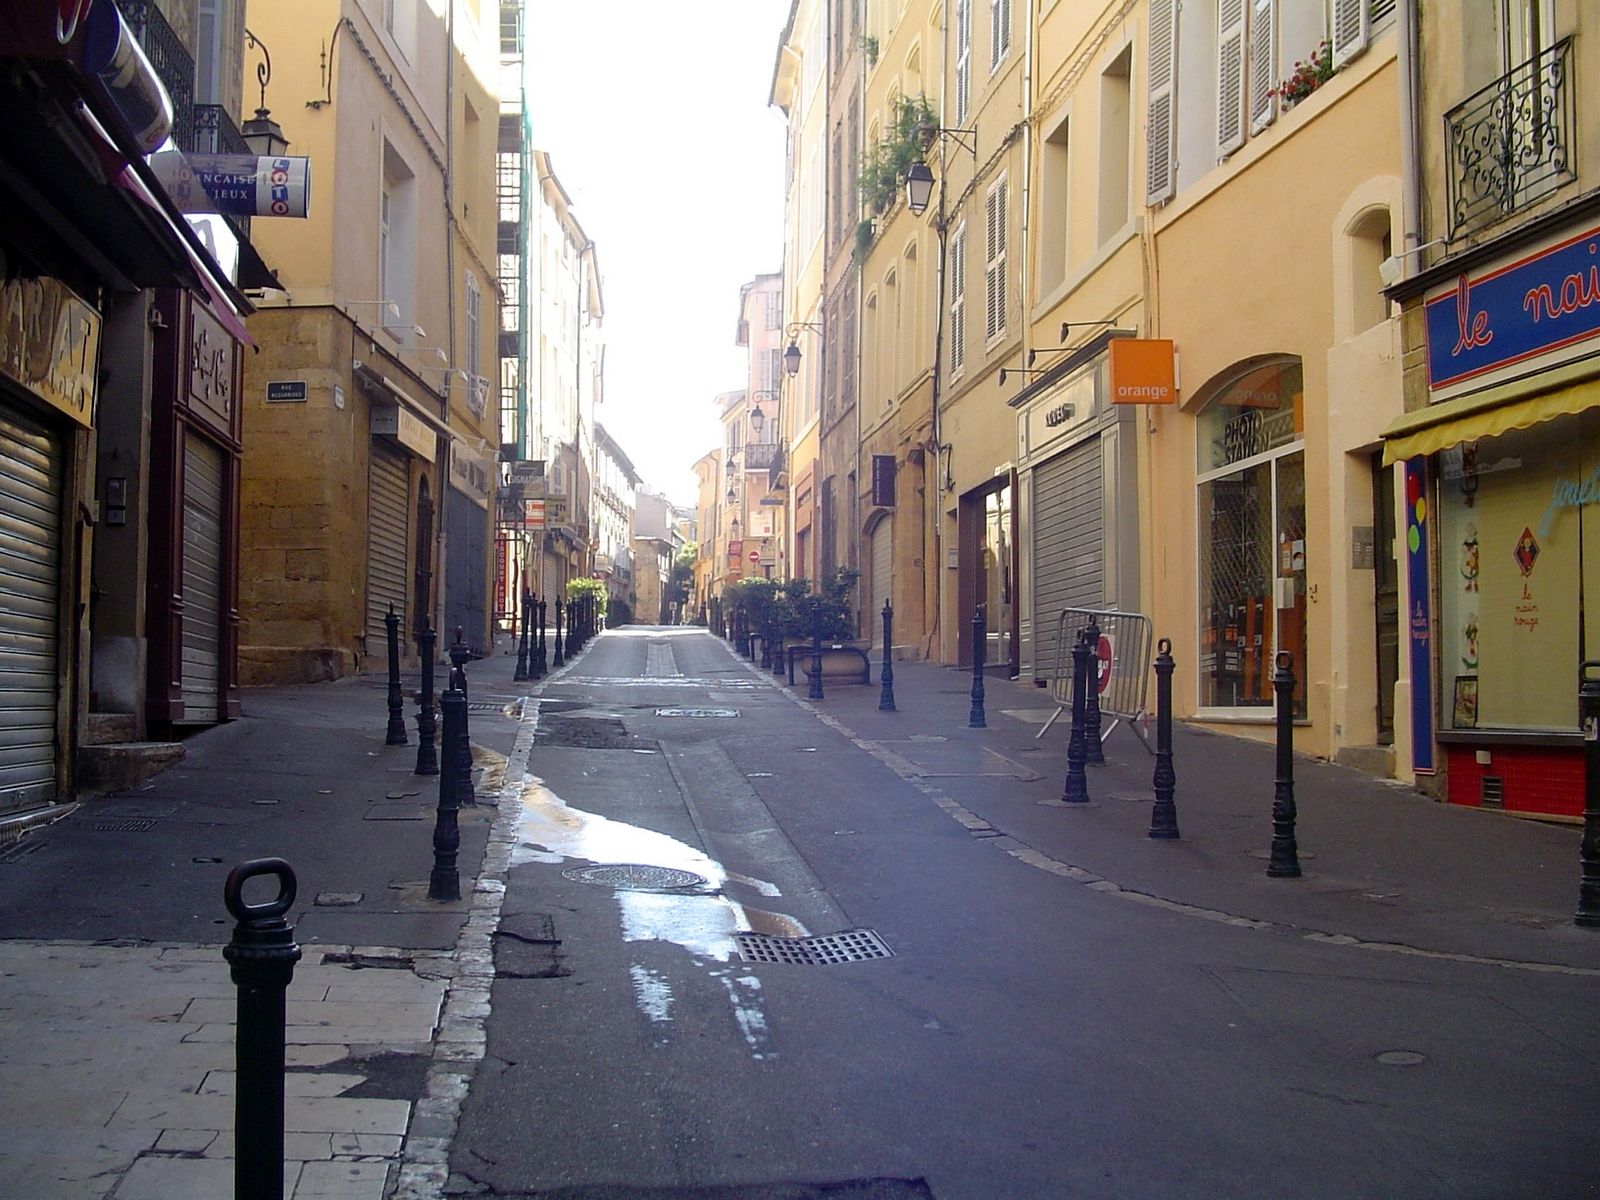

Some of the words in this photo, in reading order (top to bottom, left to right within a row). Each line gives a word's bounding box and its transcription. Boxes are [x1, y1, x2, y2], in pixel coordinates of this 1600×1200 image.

[214, 190, 248, 200] JEUX
[271, 159, 289, 215] LOTO
[1452, 272, 1493, 356] le
[1118, 386, 1168, 400] orange
[1224, 409, 1264, 446] PHOTO
[1522, 583, 1532, 600] le
[1513, 616, 1539, 632] rouge
